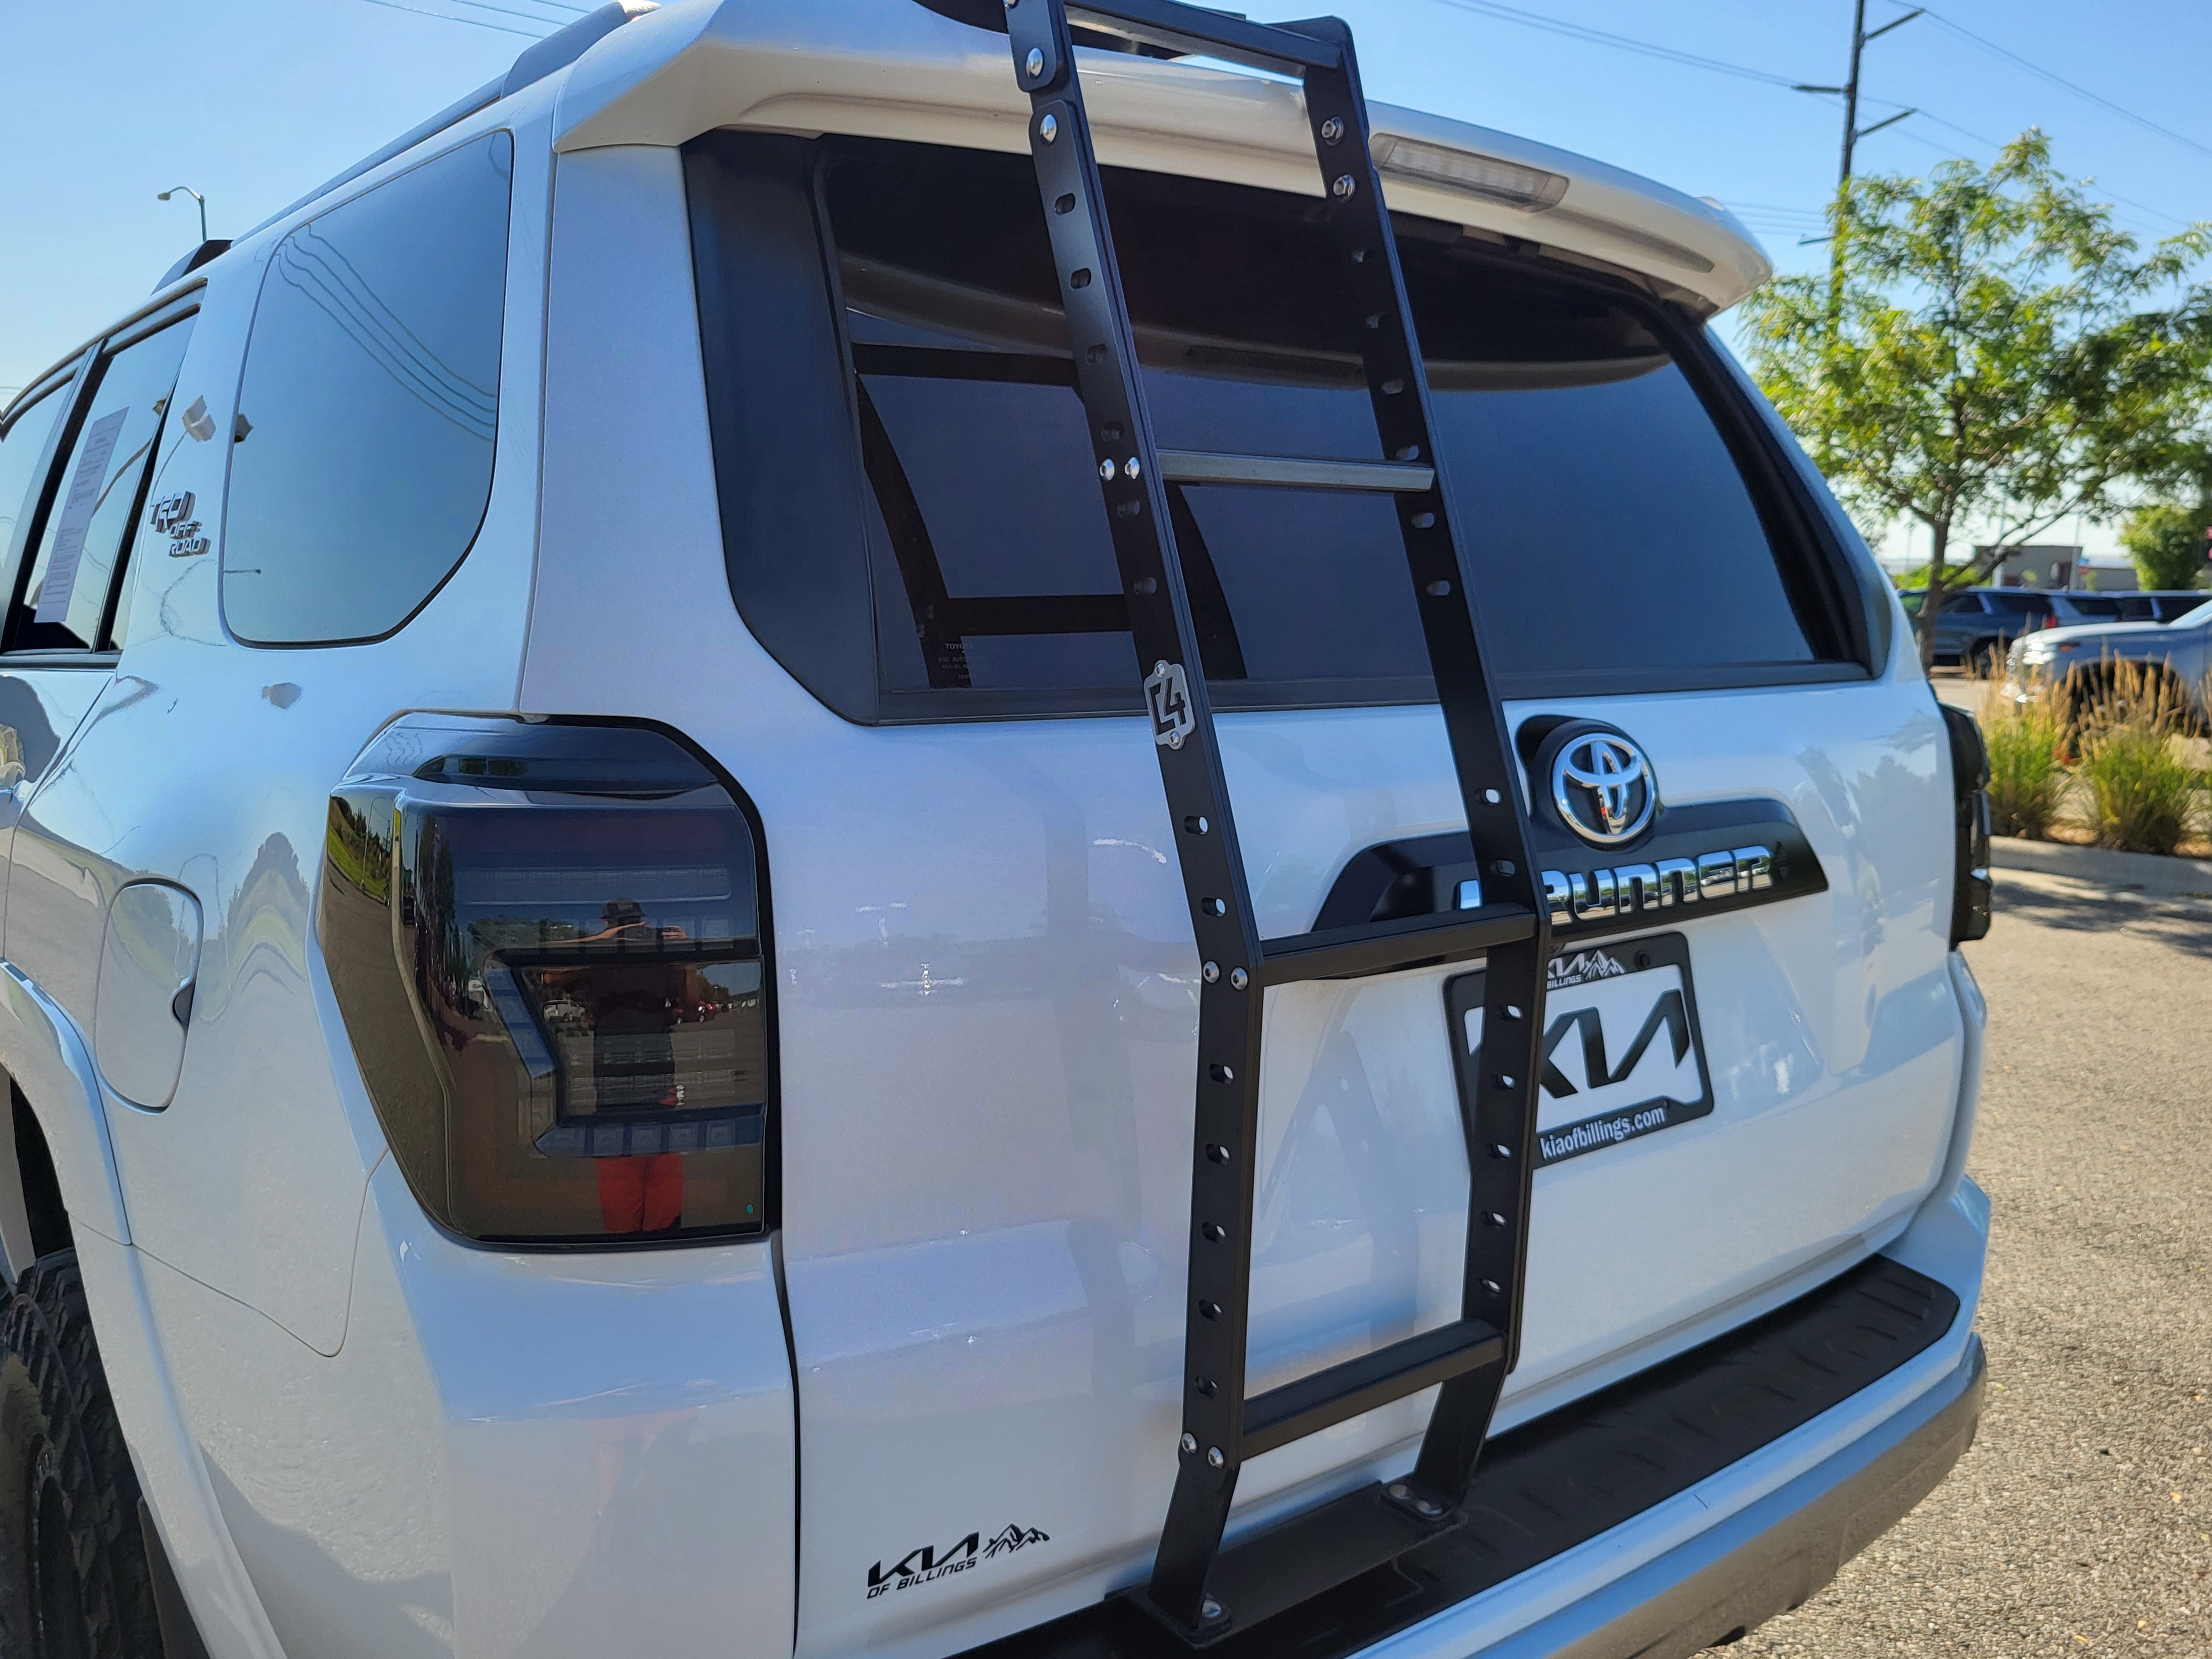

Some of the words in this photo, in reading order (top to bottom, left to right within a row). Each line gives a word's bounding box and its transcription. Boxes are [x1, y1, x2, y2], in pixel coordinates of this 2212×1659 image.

[150, 491, 196, 533] TRD
[169, 520, 202, 539] OFF
[168, 537, 211, 557] ROAD
[1547, 974, 1582, 989] BILLINGS
[1540, 1107, 1666, 1160] kiaofbillings.com
[867, 1583, 891, 1599] OF
[896, 1556, 978, 1590] BILLINGS
